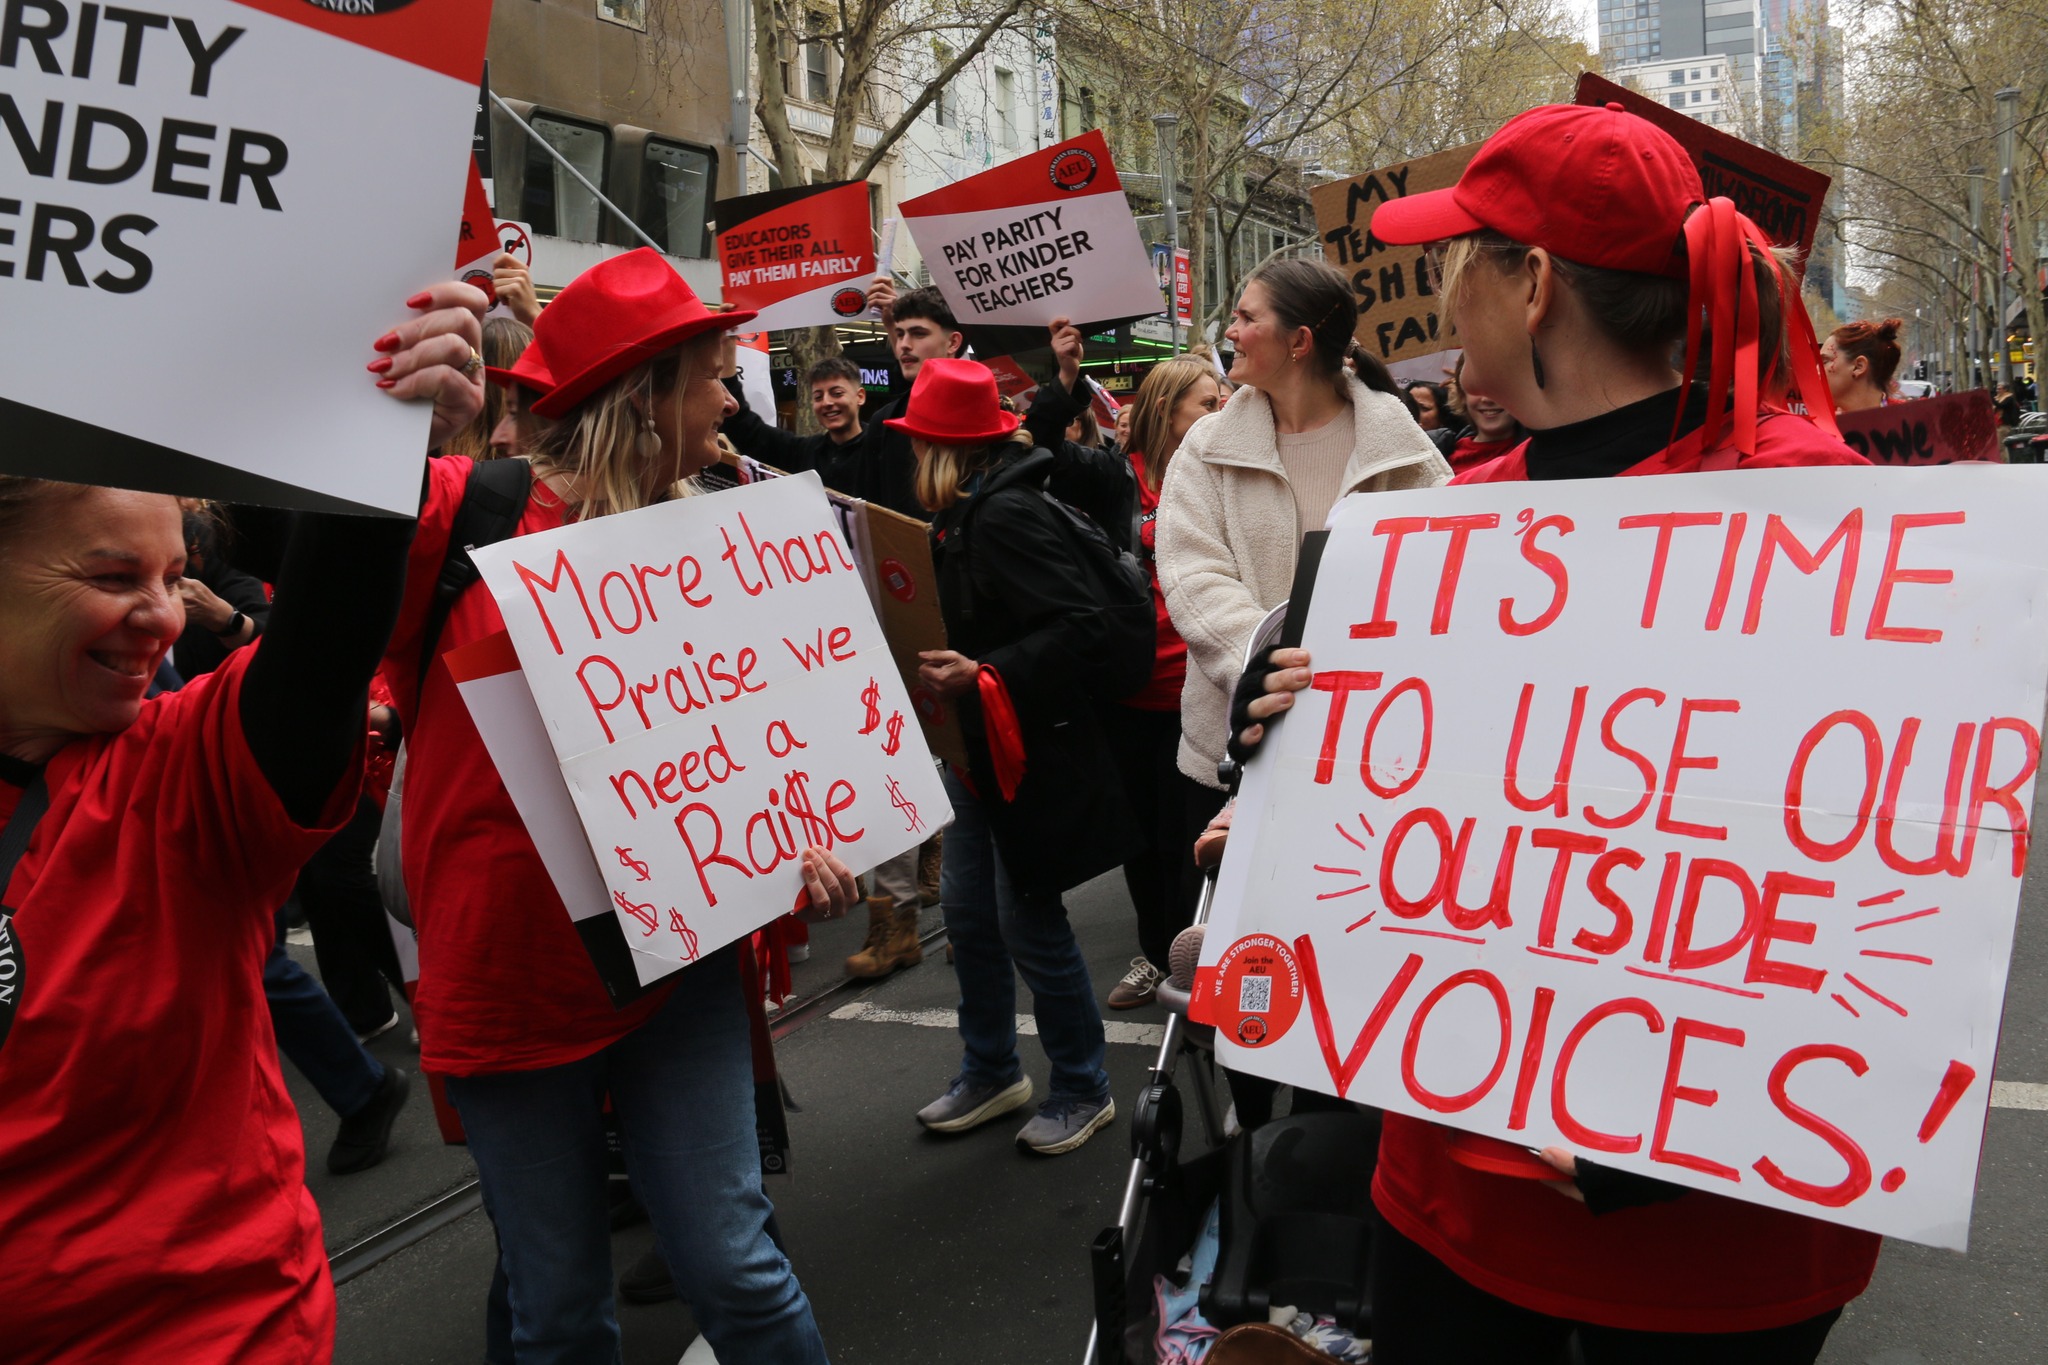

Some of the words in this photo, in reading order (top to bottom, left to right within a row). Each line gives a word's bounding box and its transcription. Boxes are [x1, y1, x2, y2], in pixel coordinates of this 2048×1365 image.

[1059, 159, 1088, 180] AEU
[1346, 165, 1409, 224] MY
[725, 223, 811, 251] EDUCATORS
[727, 251, 758, 269] GIVE
[759, 244, 805, 263] THEIR
[810, 239, 845, 258] ALL
[942, 236, 978, 266] PAY
[981, 206, 1062, 254] PARITY
[729, 269, 752, 288] PAY
[754, 263, 797, 285] THEM
[801, 255, 862, 278] FAIRLY
[954, 262, 997, 291] FOR
[996, 230, 1094, 279] KINDER
[966, 266, 1074, 314] TEACHERS
[513, 549, 713, 656] More
[720, 511, 854, 597] than
[1348, 507, 1576, 640] IT'S
[1618, 507, 1967, 645] TIME
[575, 641, 768, 744] Praise
[782, 626, 857, 672] we
[608, 724, 746, 820] need
[766, 719, 808, 758] a
[1311, 670, 1434, 800] TO
[1503, 682, 1742, 842] USE
[1782, 708, 2042, 879] OUR
[1378, 806, 1836, 994] OUTSIDE
[1218, 957, 1232, 978] ARE
[1230, 937, 1275, 959] STRONGER
[1242, 955, 1259, 965] Join
[1261, 955, 1274, 965] the
[1249, 965, 1266, 974] AEU
[1215, 978, 1223, 996] WE
[1243, 1024, 1262, 1034] AEU
[1293, 933, 1977, 1209] VOICES!
